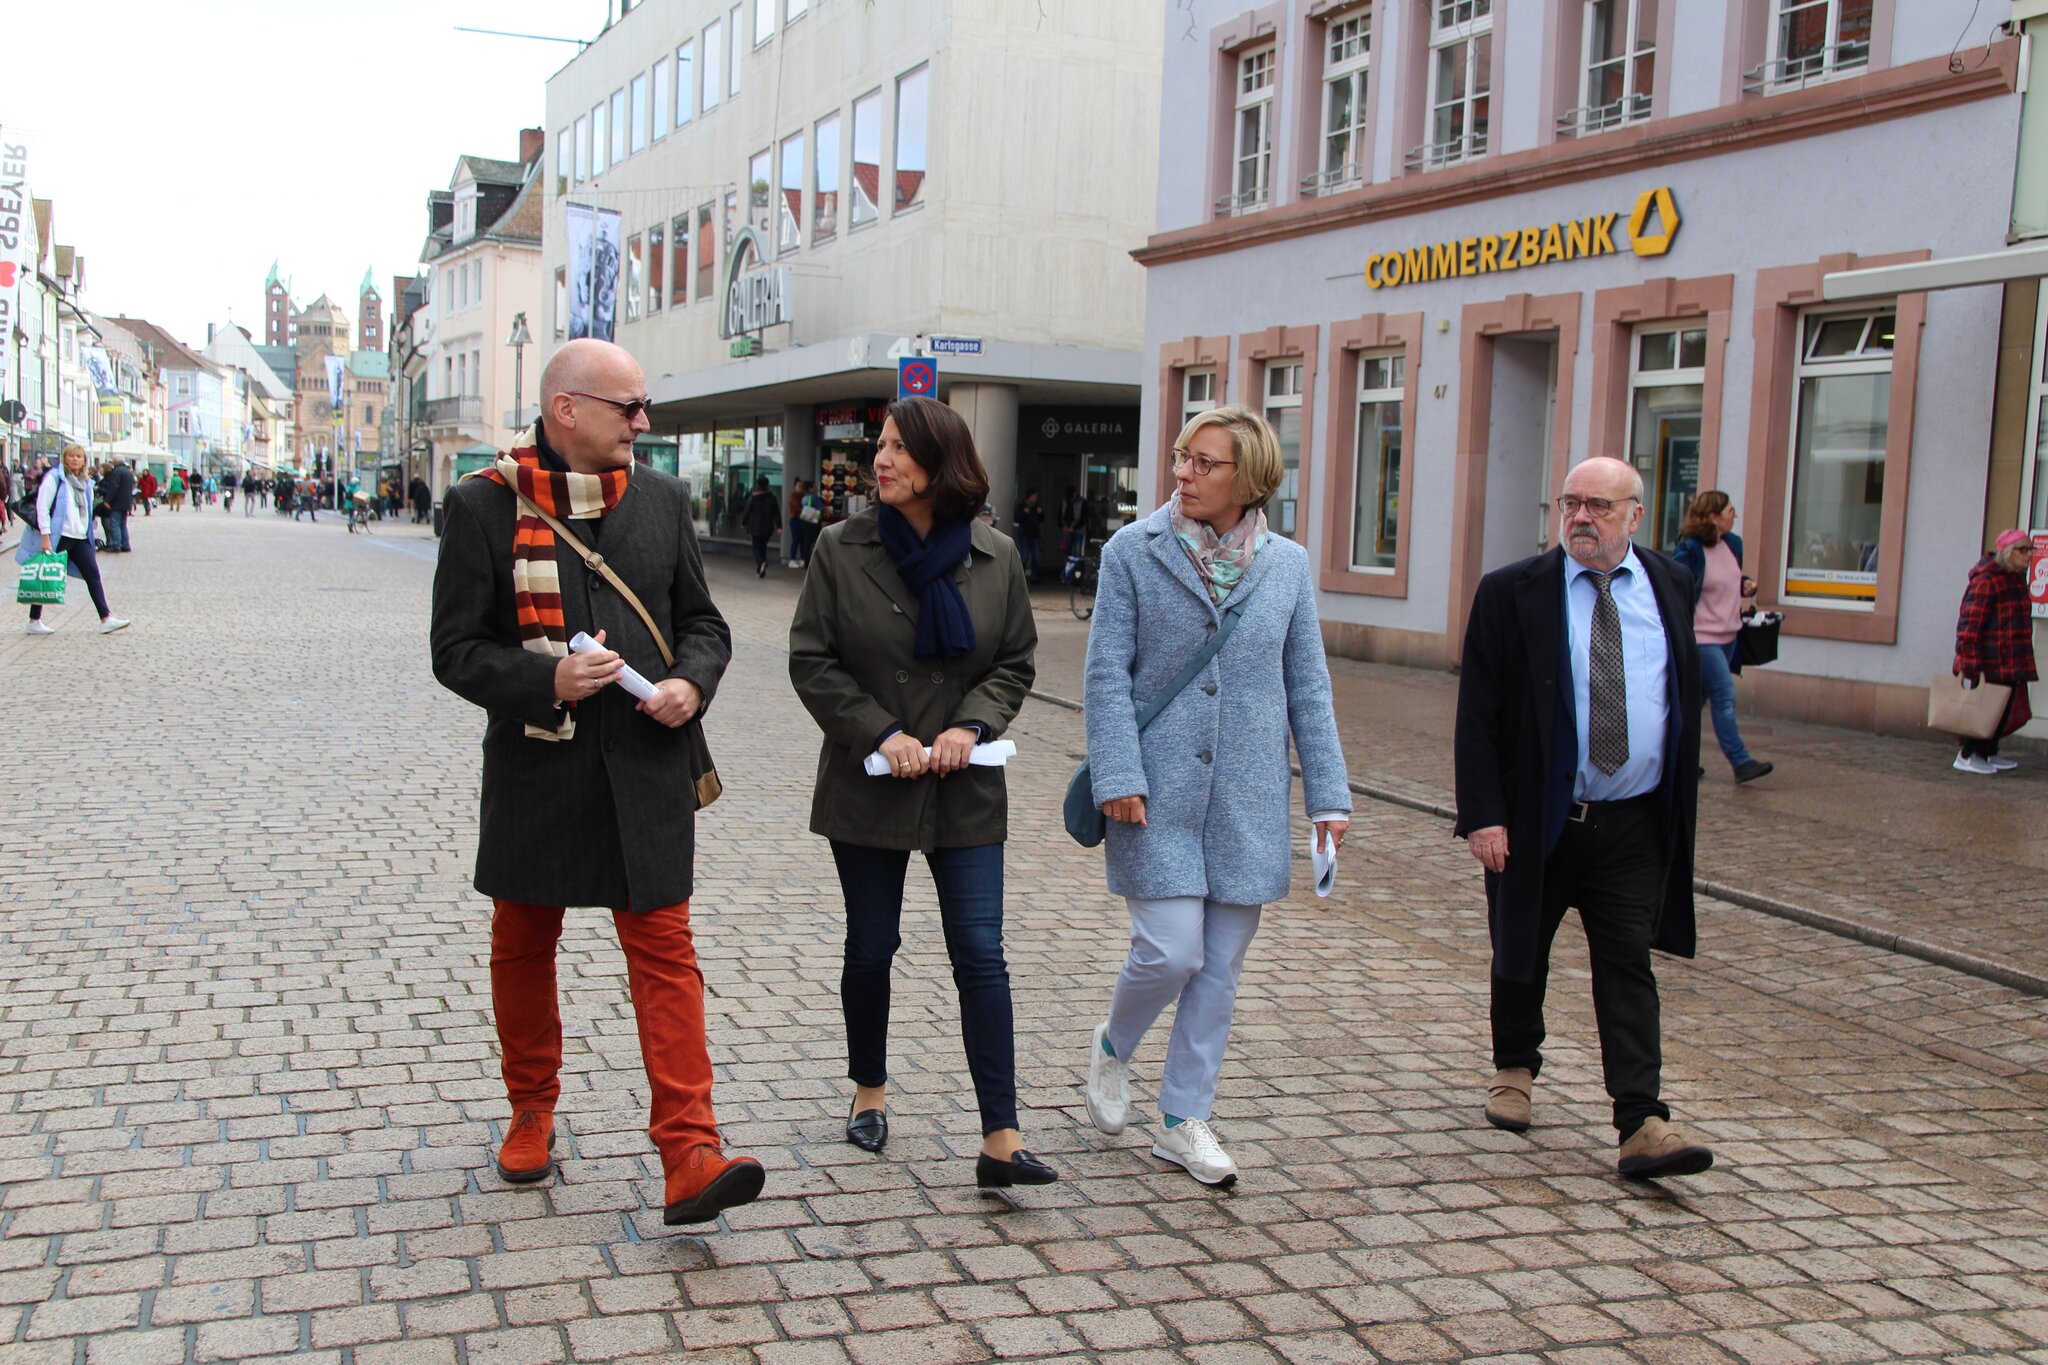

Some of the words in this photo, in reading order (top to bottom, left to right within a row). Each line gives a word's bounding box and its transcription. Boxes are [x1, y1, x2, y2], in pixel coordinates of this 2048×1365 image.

[1364, 211, 1618, 289] COMMERZBANK
[729, 266, 784, 335] GALERIA
[934, 339, 979, 352] Karlsgasse
[1064, 422, 1123, 434] GALERIA
